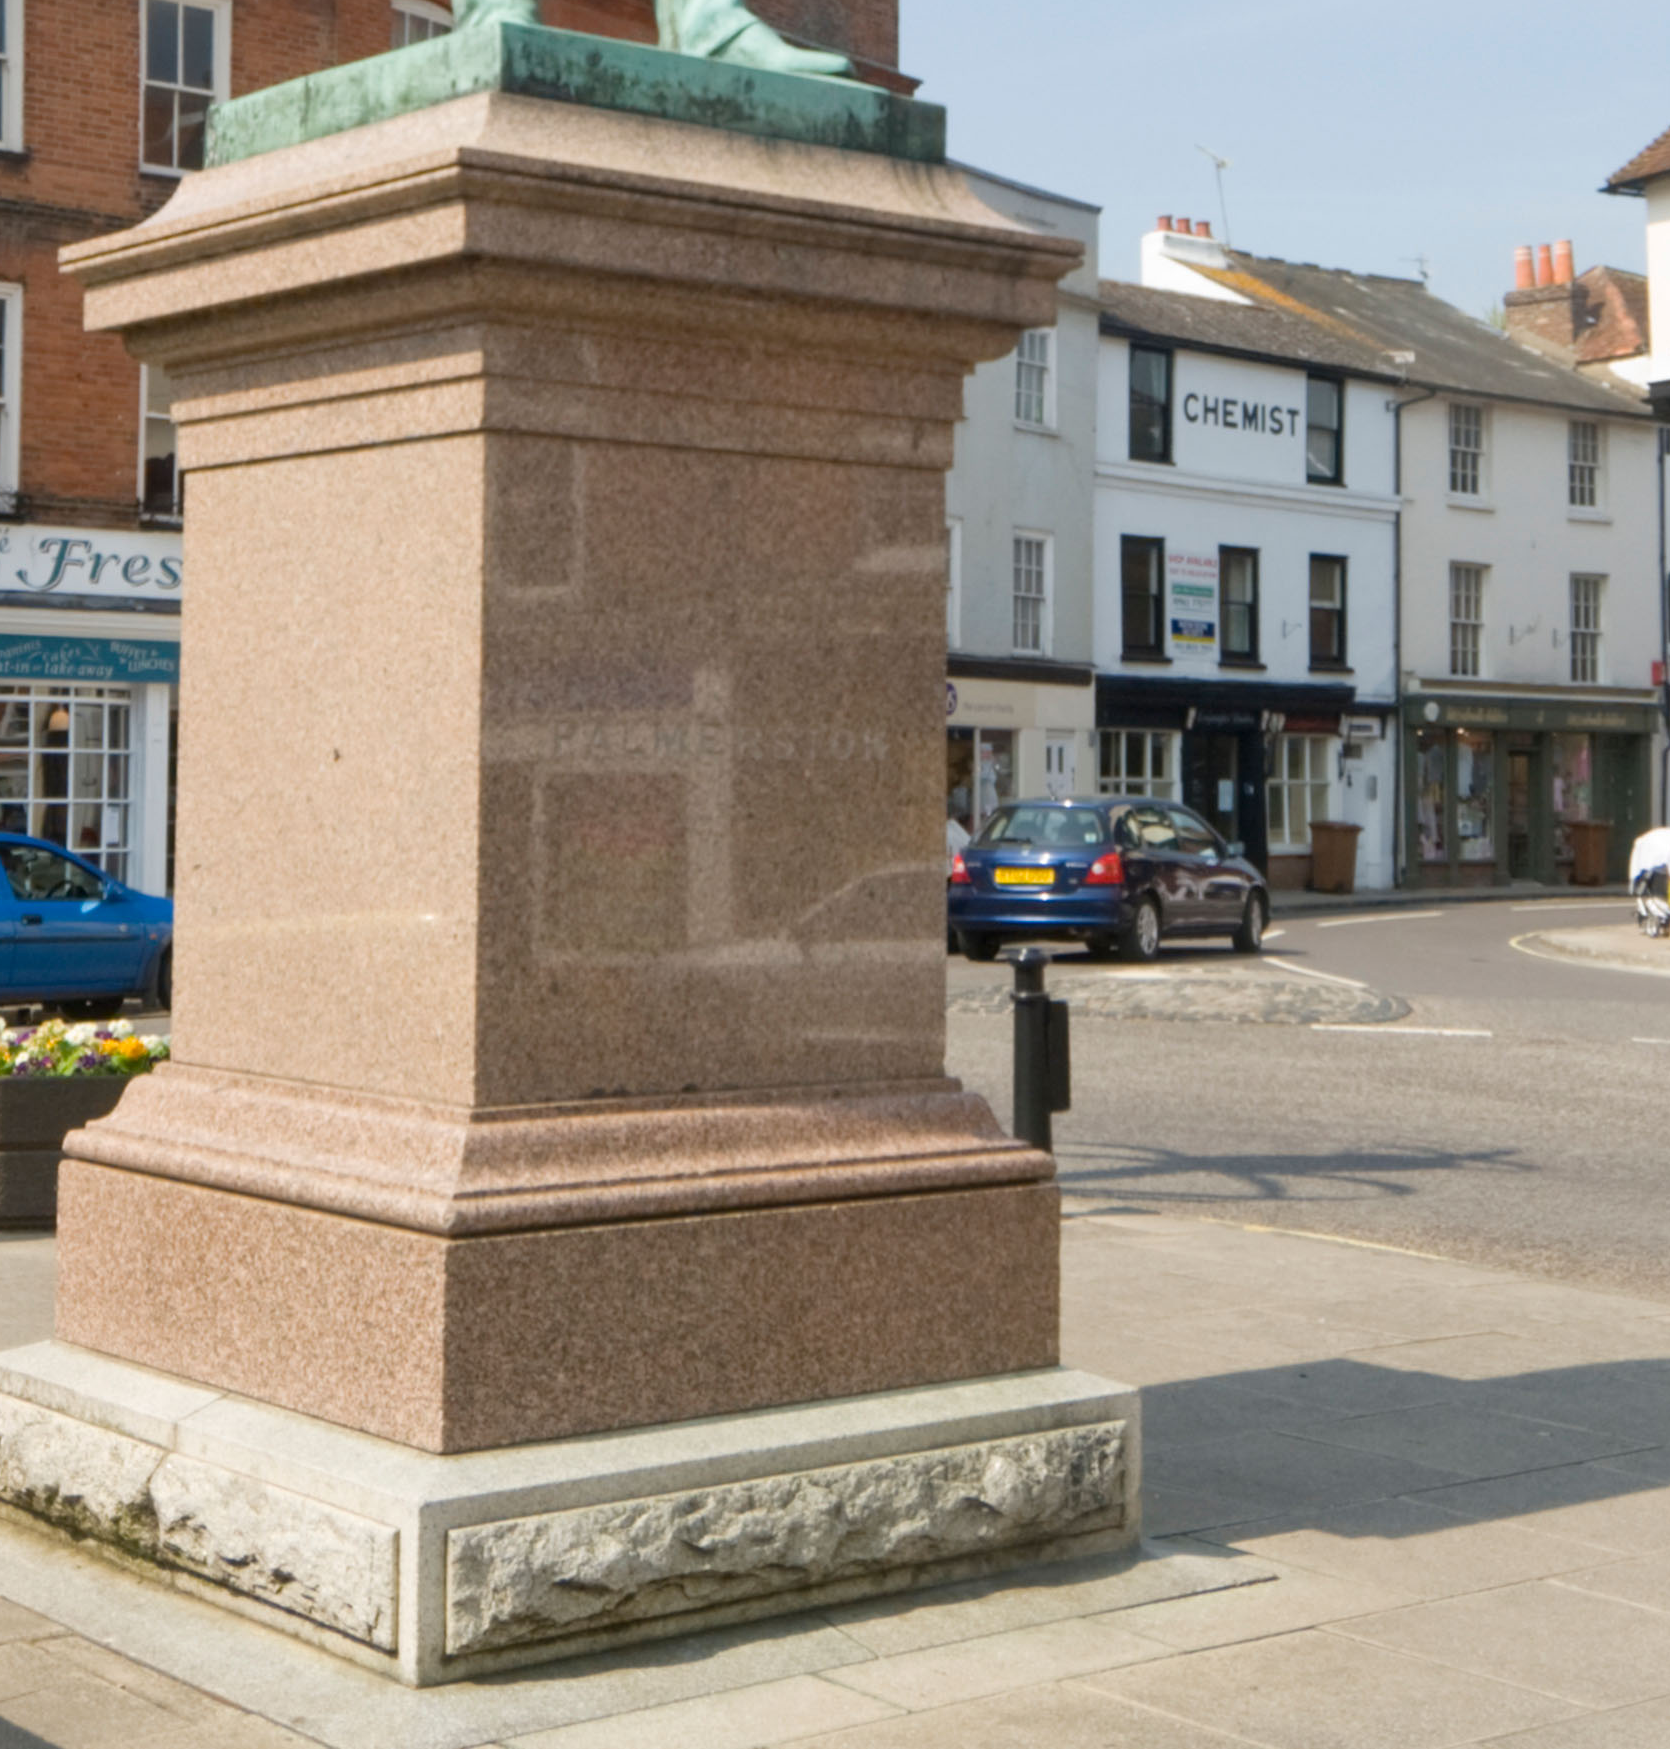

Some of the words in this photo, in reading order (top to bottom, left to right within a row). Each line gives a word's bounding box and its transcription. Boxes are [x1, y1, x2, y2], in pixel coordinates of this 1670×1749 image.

[1183, 392, 1300, 437] CHEMIST
[16, 536, 182, 592] Fres
[551, 720, 890, 761] PALMERSTON
